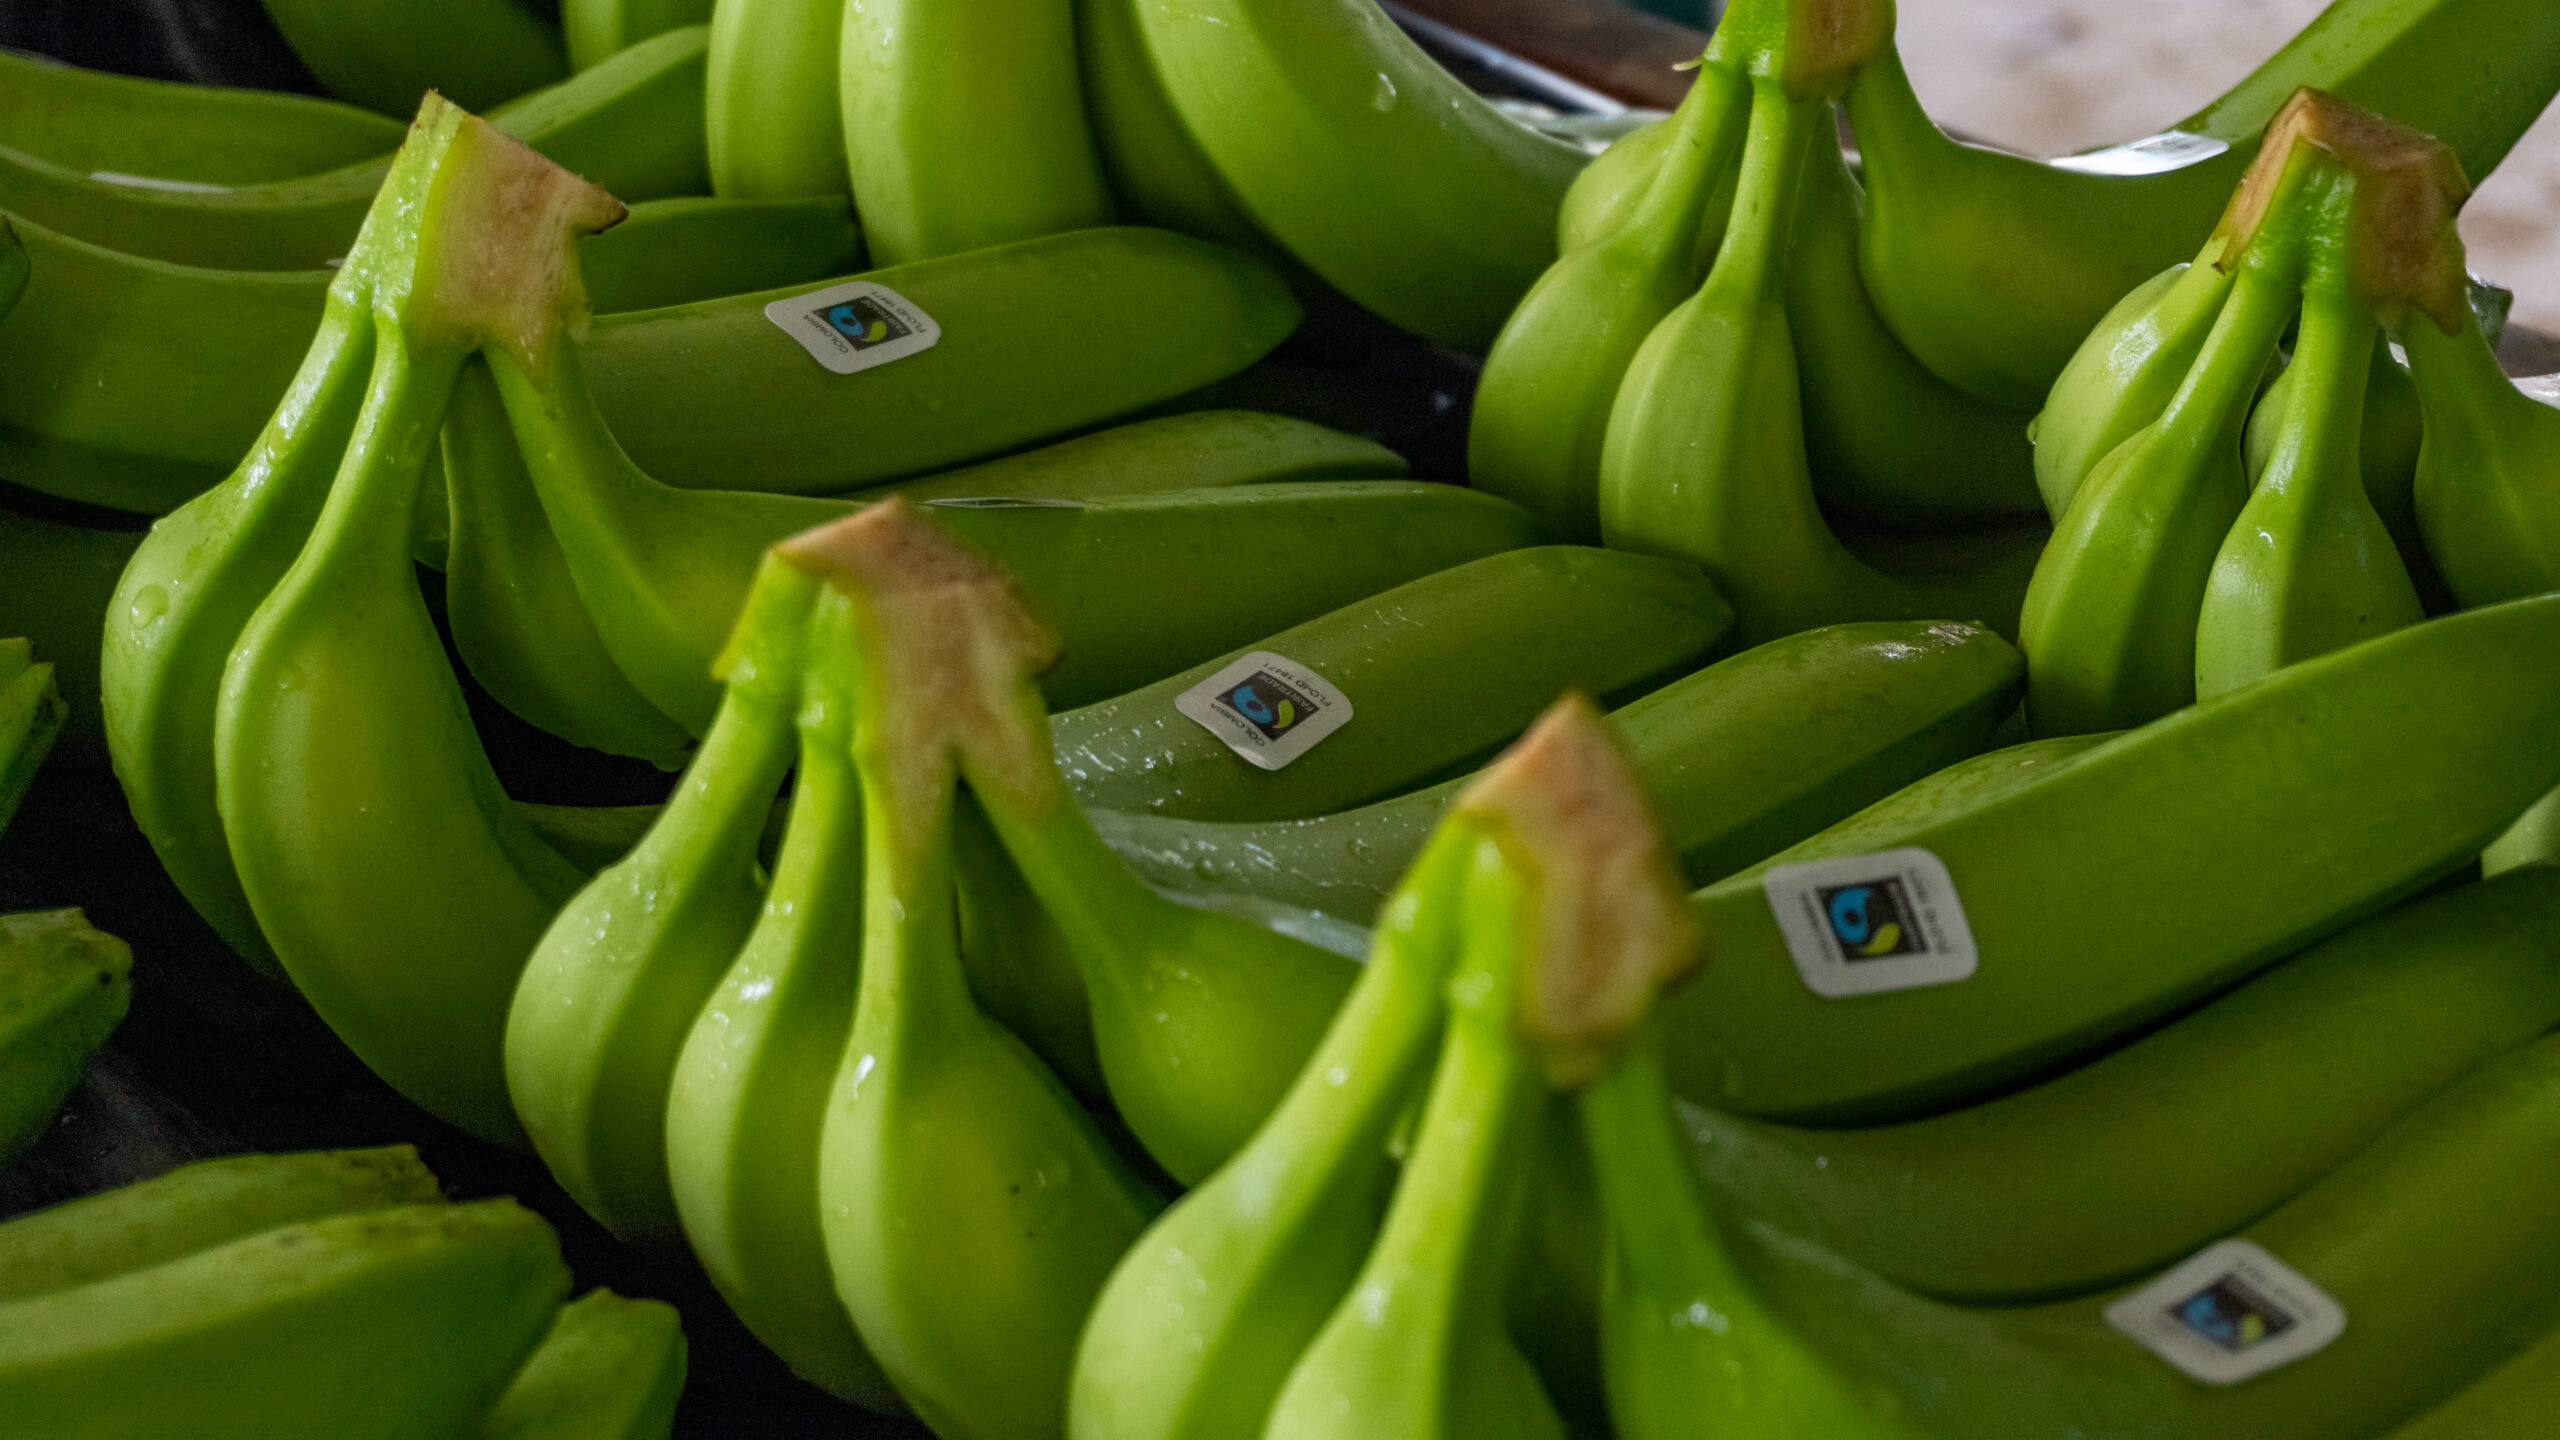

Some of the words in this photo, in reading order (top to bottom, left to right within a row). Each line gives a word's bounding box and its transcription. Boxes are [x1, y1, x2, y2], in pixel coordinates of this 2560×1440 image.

[803, 314, 849, 354] COLOMBIA
[1256, 673, 1315, 712] FAIRTRADE
[1295, 680, 1332, 708] FLO-ID
[1210, 703, 1265, 747] COLOMBIA
